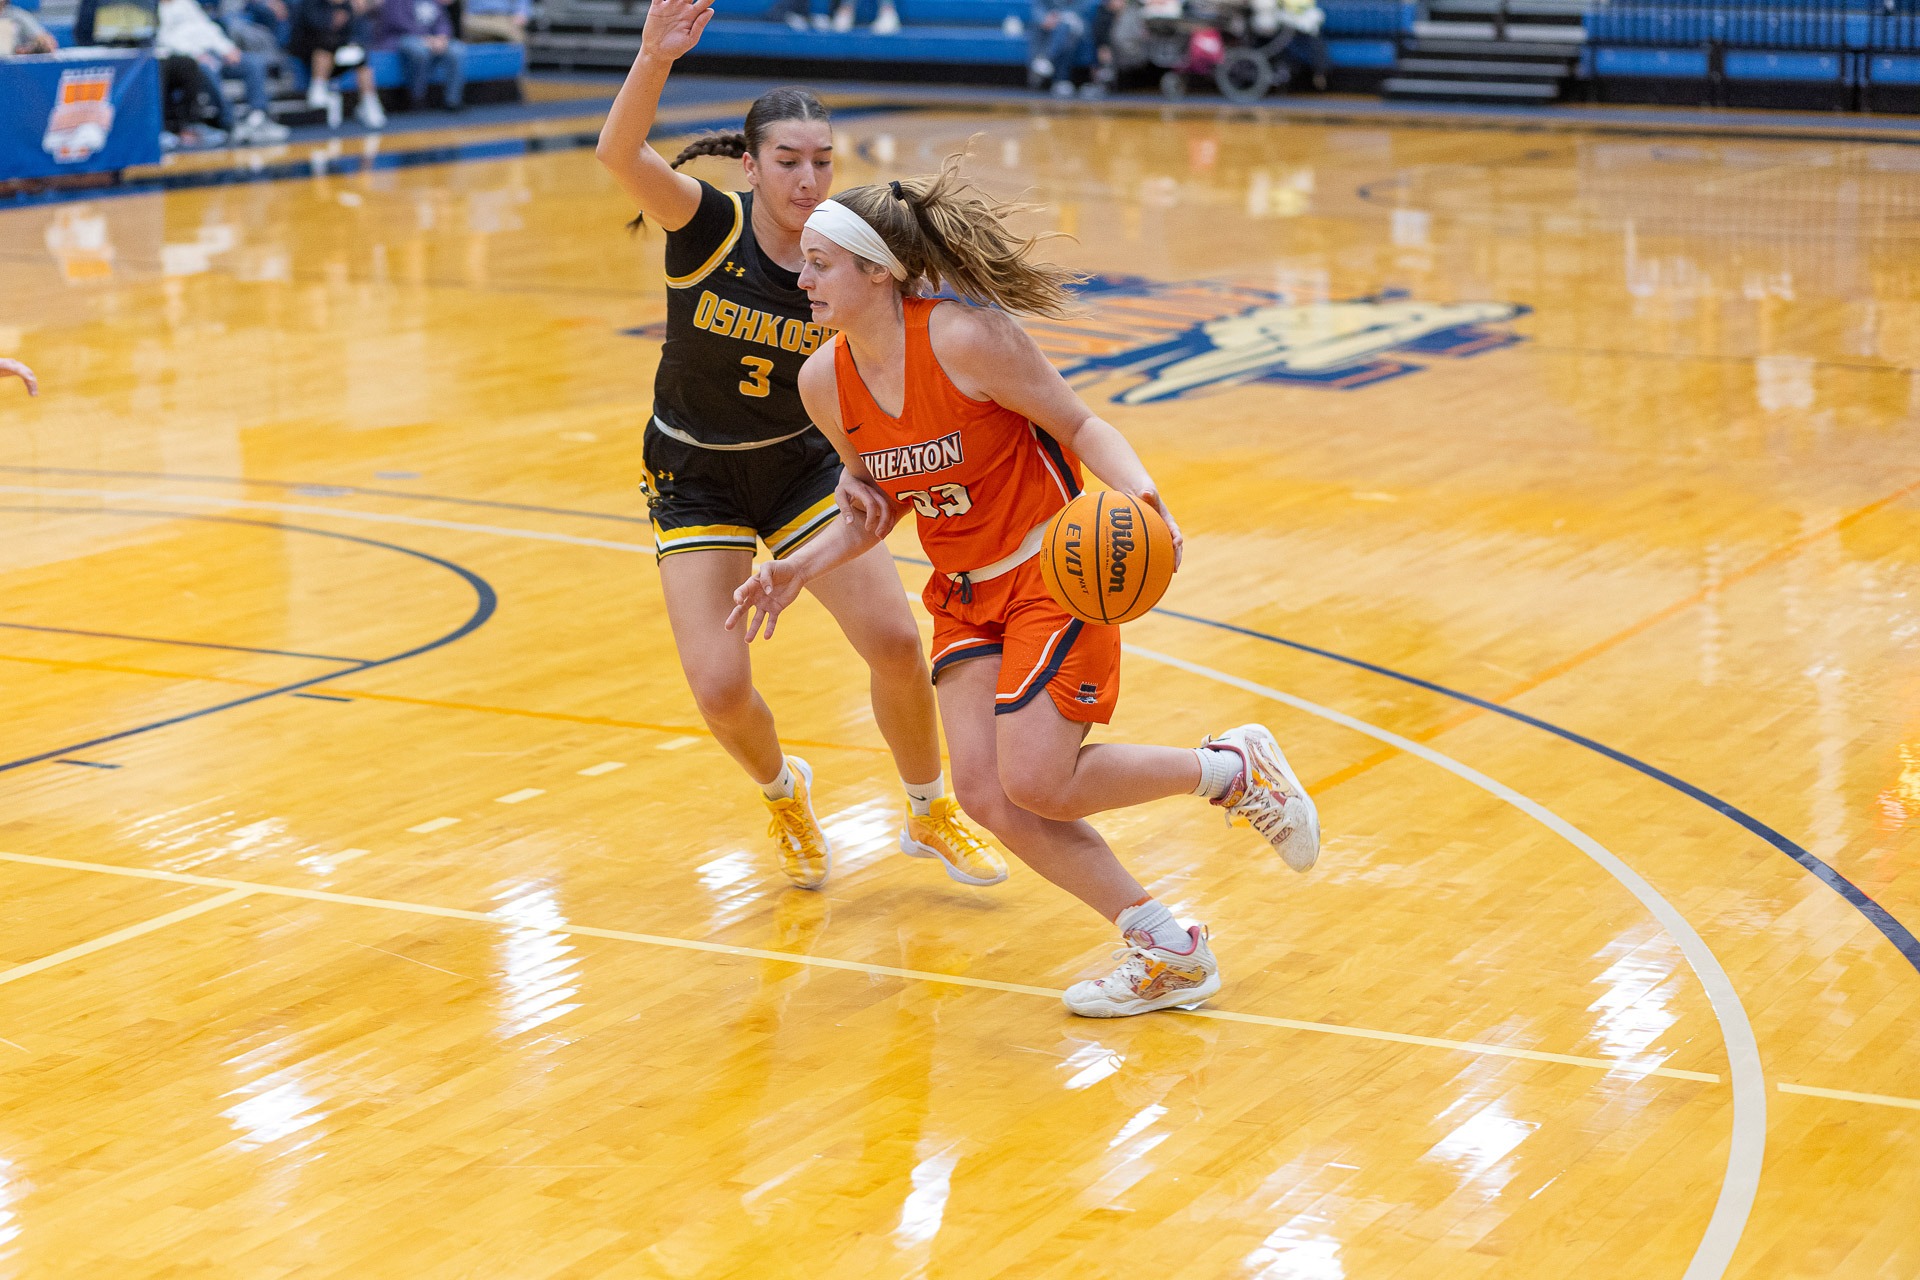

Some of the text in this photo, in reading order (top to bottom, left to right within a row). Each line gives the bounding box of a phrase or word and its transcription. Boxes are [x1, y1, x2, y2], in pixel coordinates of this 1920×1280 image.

[739, 355, 774, 397] 3
[1065, 523, 1089, 595] EVO NXT
[1108, 507, 1135, 594] Wilson
